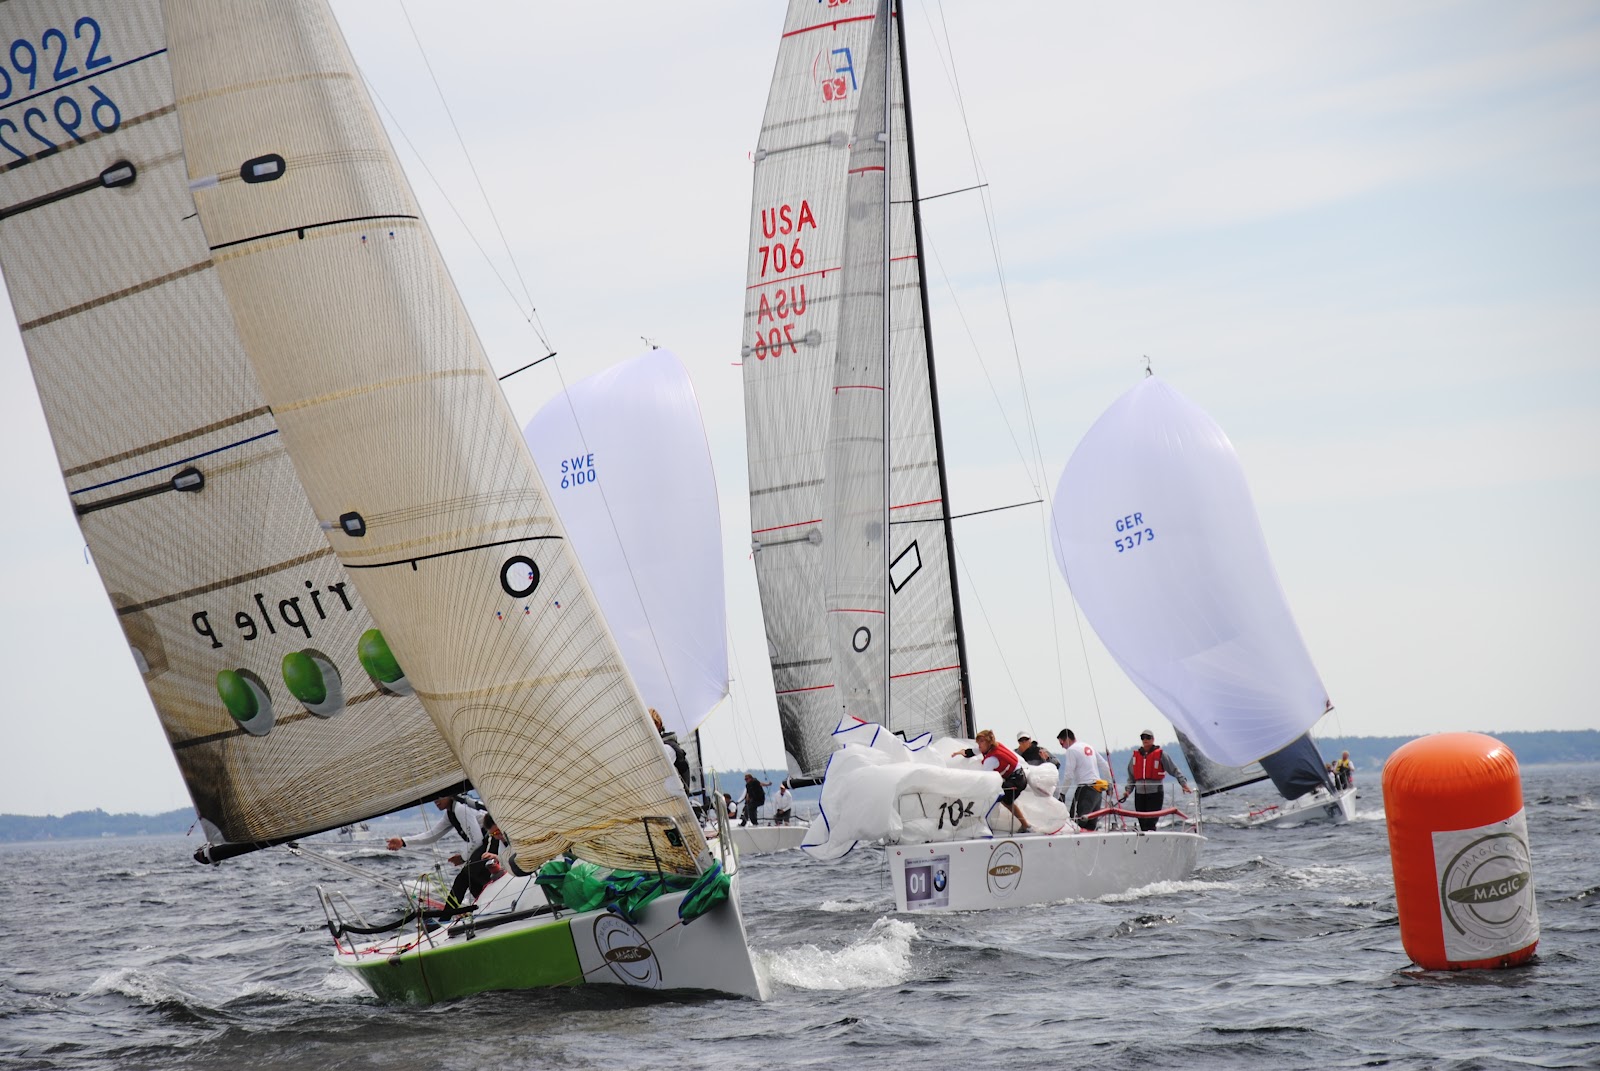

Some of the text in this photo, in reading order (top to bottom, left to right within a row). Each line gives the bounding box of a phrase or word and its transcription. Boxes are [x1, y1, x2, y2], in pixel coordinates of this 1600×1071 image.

[761, 200, 817, 239] USA
[758, 237, 805, 278] 706
[560, 453, 594, 474] SWE
[560, 468, 596, 489] 6100
[1115, 512, 1144, 532] GER
[1114, 527, 1155, 553] 5373
[1461, 843, 1500, 870] MAGIC
[995, 866, 1014, 875] MAGIC
[909, 873, 926, 894] 01
[1473, 877, 1520, 901] MAGIC
[615, 949, 642, 959] MAGIC
